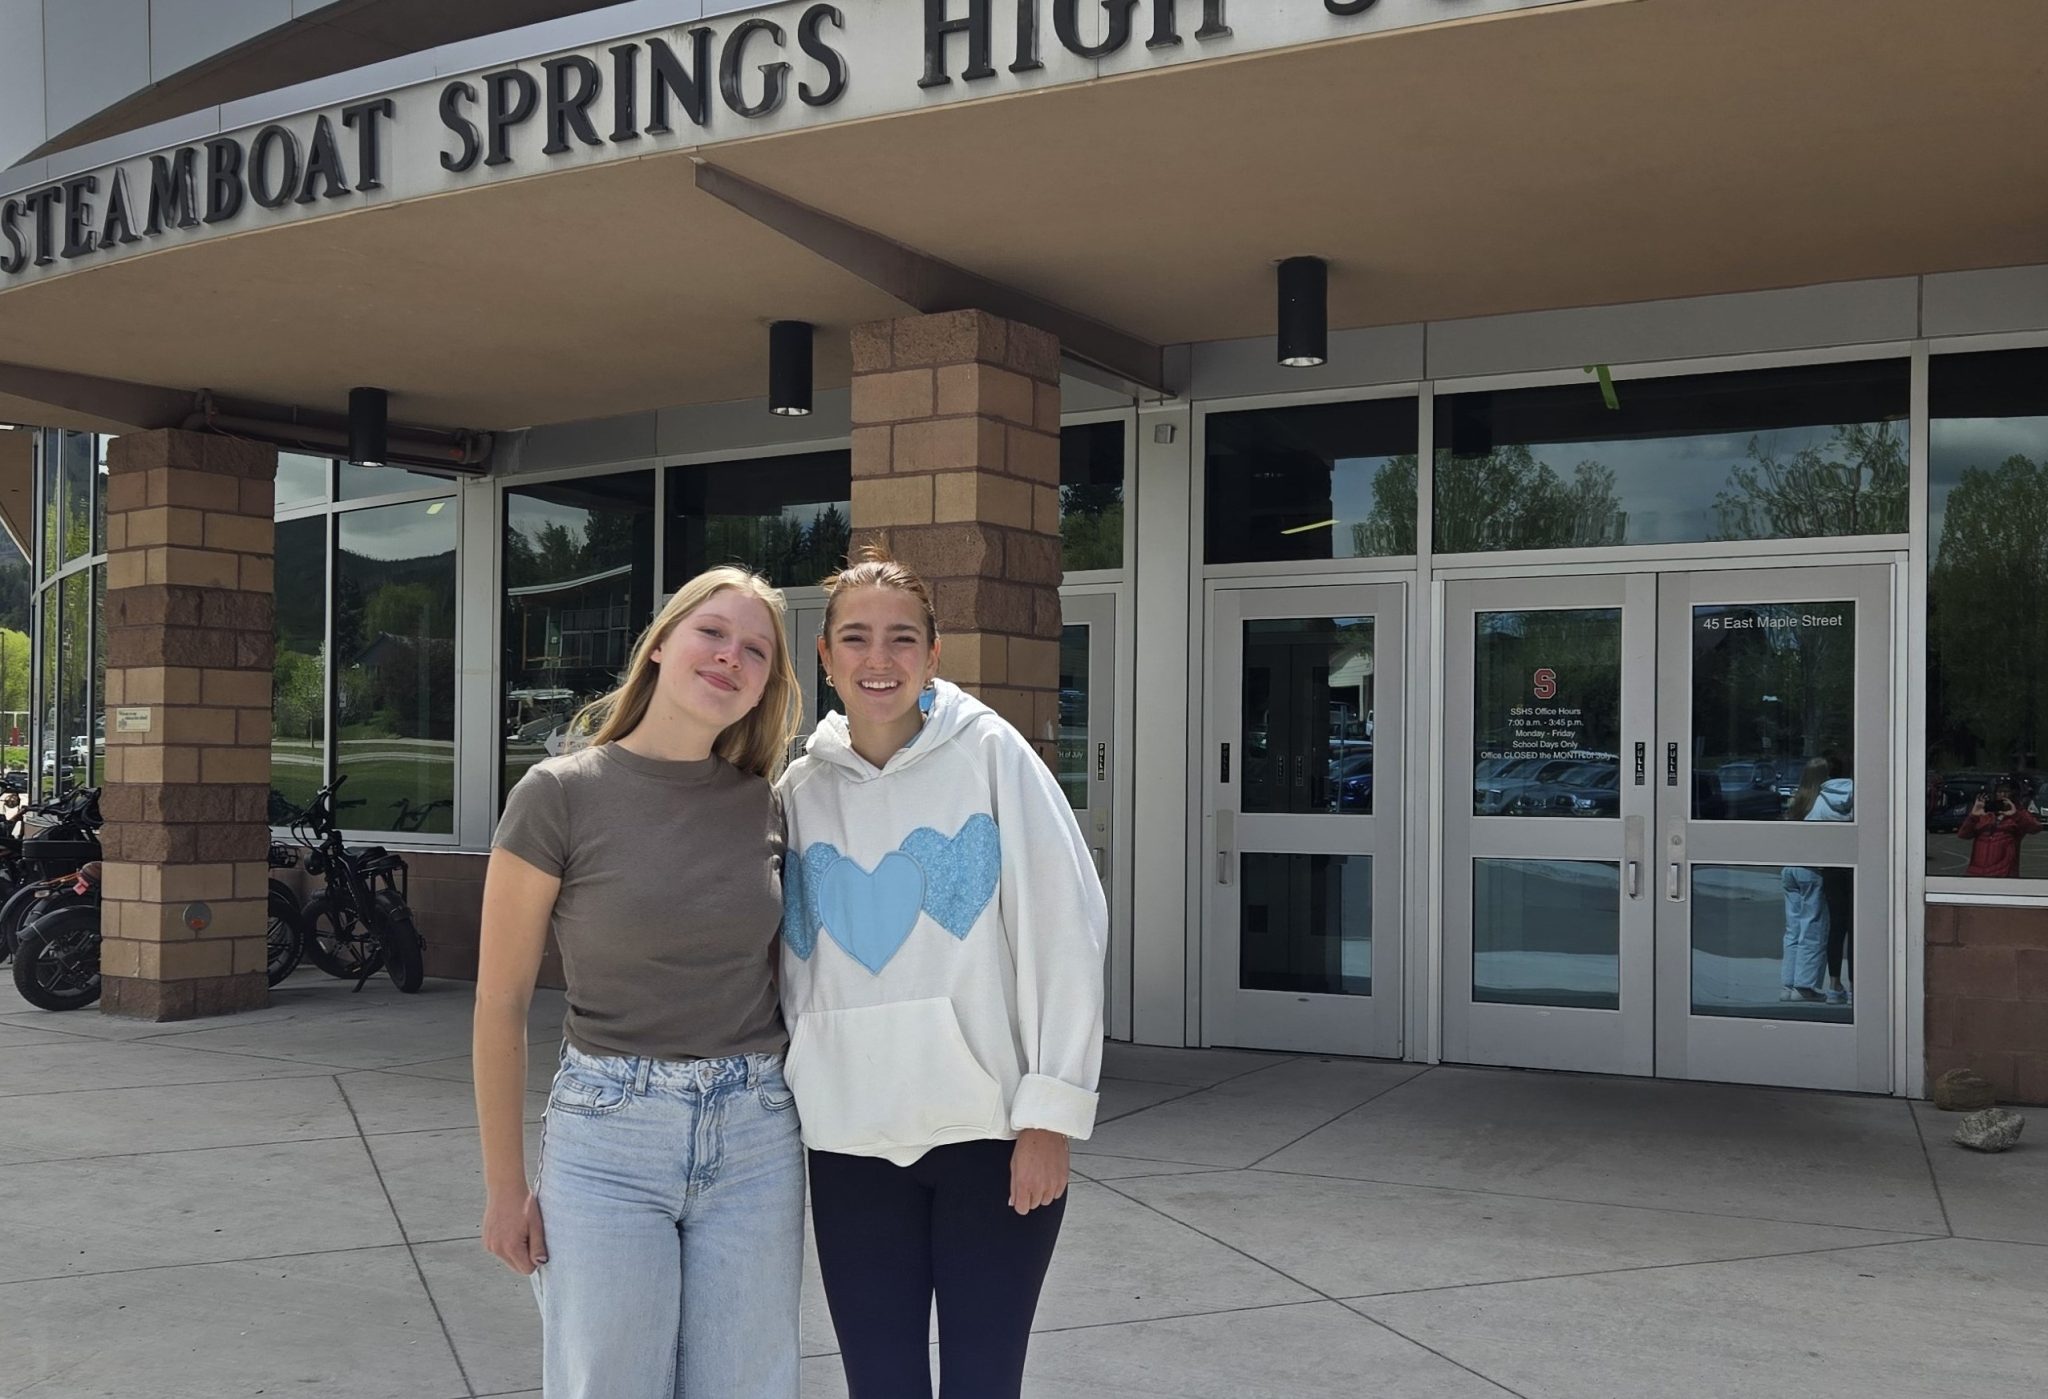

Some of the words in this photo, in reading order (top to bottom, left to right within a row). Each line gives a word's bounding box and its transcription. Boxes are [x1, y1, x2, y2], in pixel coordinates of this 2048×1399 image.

[0, 98, 393, 273] STEAMBOAT
[439, 3, 849, 173] SPRINGS
[1703, 618, 1720, 630] 45
[1724, 617, 1753, 629] East
[1757, 616, 1798, 630] Maple
[1801, 614, 1842, 627] Street
[1534, 668, 1556, 699] S
[1510, 707, 1533, 716] SSHS
[1535, 707, 1557, 716] Office
[1558, 707, 1581, 716] Hours
[1508, 719, 1524, 727] 7:00
[1548, 719, 1565, 727] 3:45
[1567, 719, 1584, 728] p.m.
[1515, 729, 1545, 739] Monday
[1552, 729, 1576, 739] Friday
[1512, 740, 1538, 748] School
[1540, 740, 1559, 749] Days
[1560, 740, 1578, 750] Only
[1480, 751, 1501, 760] Office
[1504, 751, 1538, 760] CLOSED
[1539, 751, 1552, 760] the
